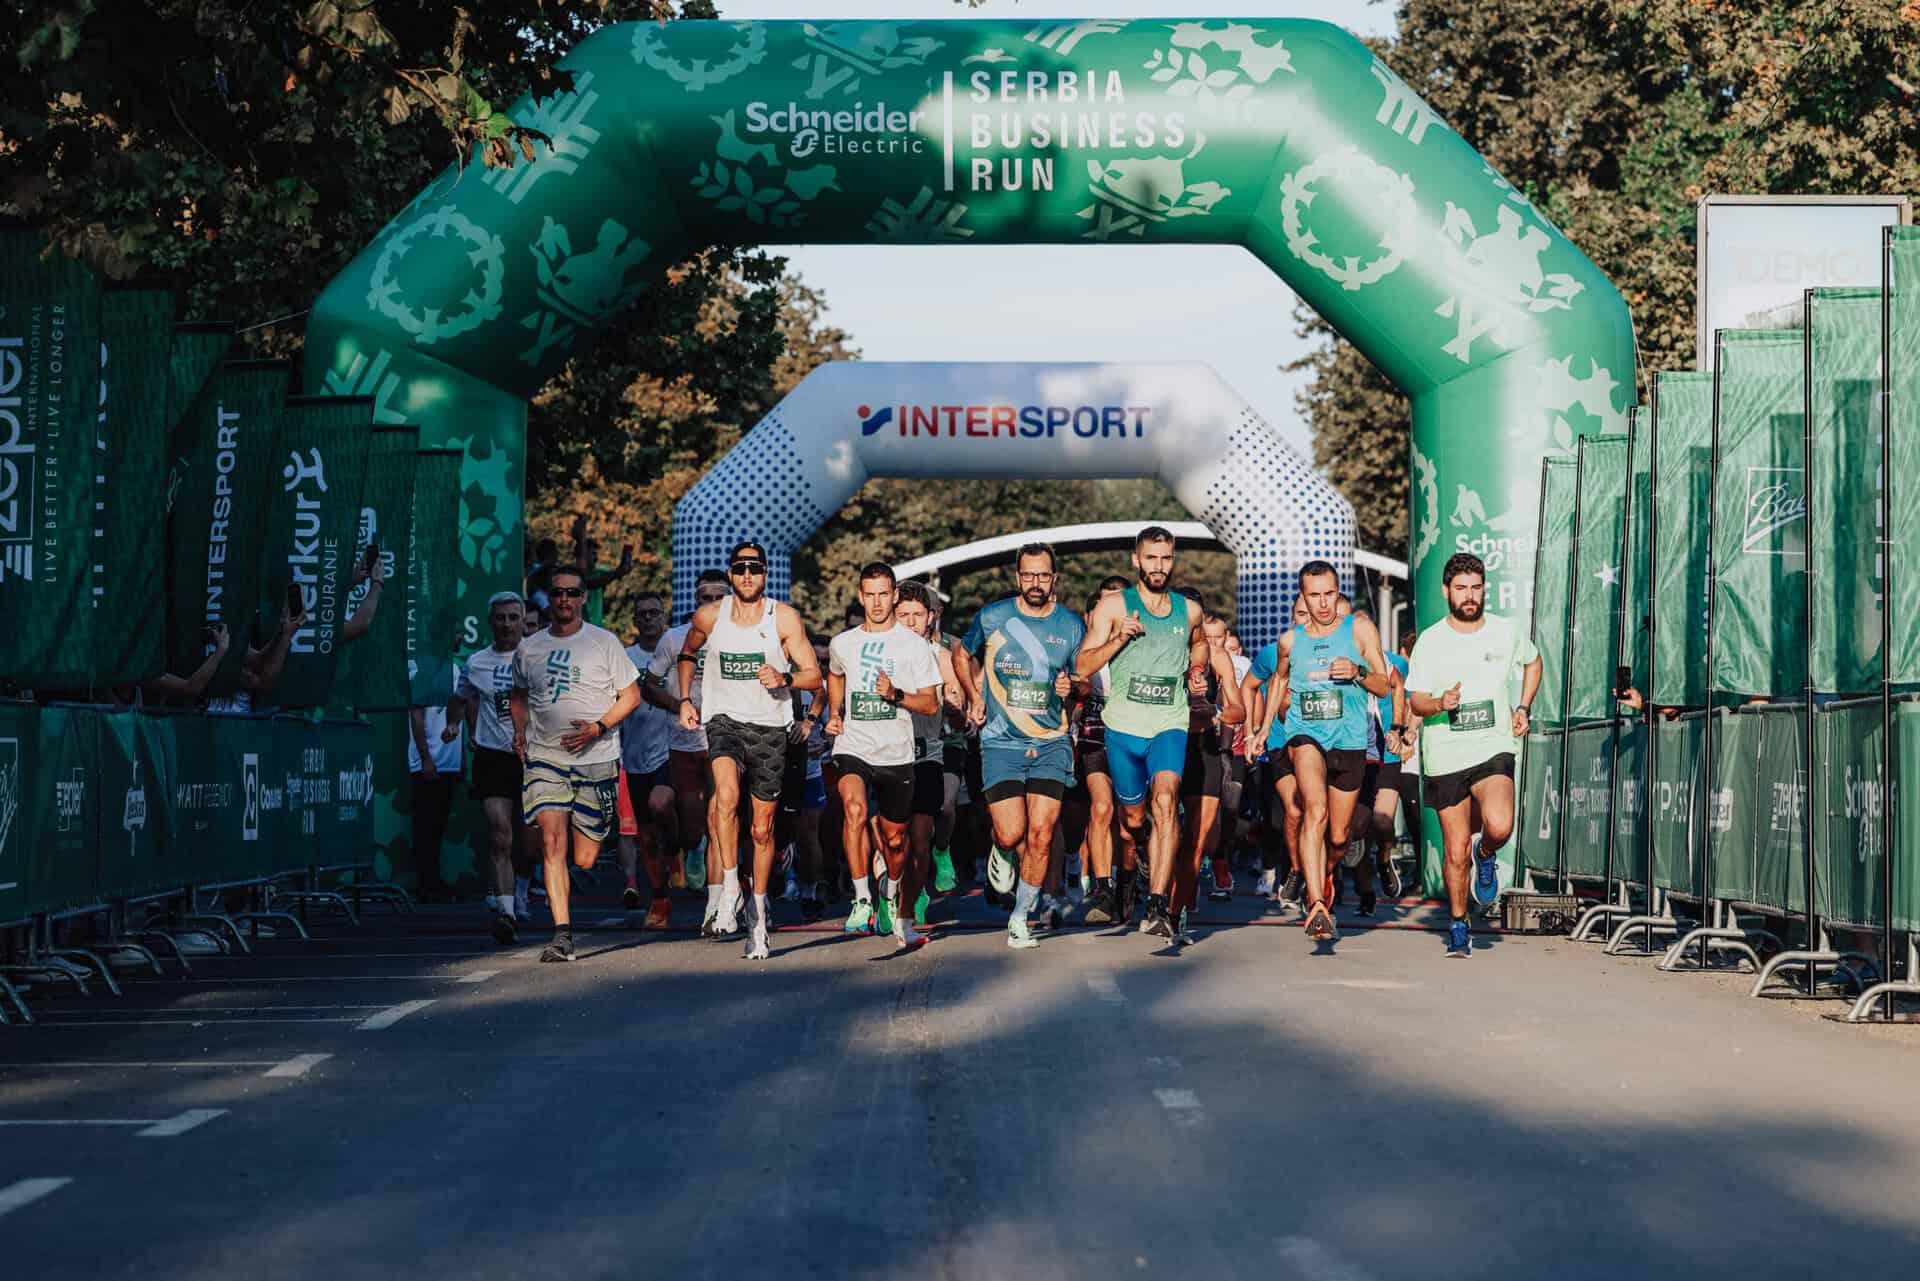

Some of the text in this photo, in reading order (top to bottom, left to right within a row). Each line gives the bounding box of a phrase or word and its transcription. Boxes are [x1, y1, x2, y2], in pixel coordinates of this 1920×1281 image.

[970, 70, 1125, 103] SERBIA
[745, 102, 925, 134] Schneider
[970, 111, 1186, 149] BUSINESS
[824, 136, 923, 155] Electric
[971, 158, 1054, 192] RUN
[28, 305, 42, 431] INTERNATIONAL
[899, 405, 1151, 438] INTERSPORT
[45, 304, 65, 583] LIVE BETTER LIVE LONGER
[205, 404, 241, 625] INTERSPORT
[319, 537, 338, 655] OSIGURANJE
[724, 661, 762, 673] 5225
[856, 700, 891, 713] 2116
[1134, 682, 1170, 698] 7402
[1304, 698, 1338, 713] 0194
